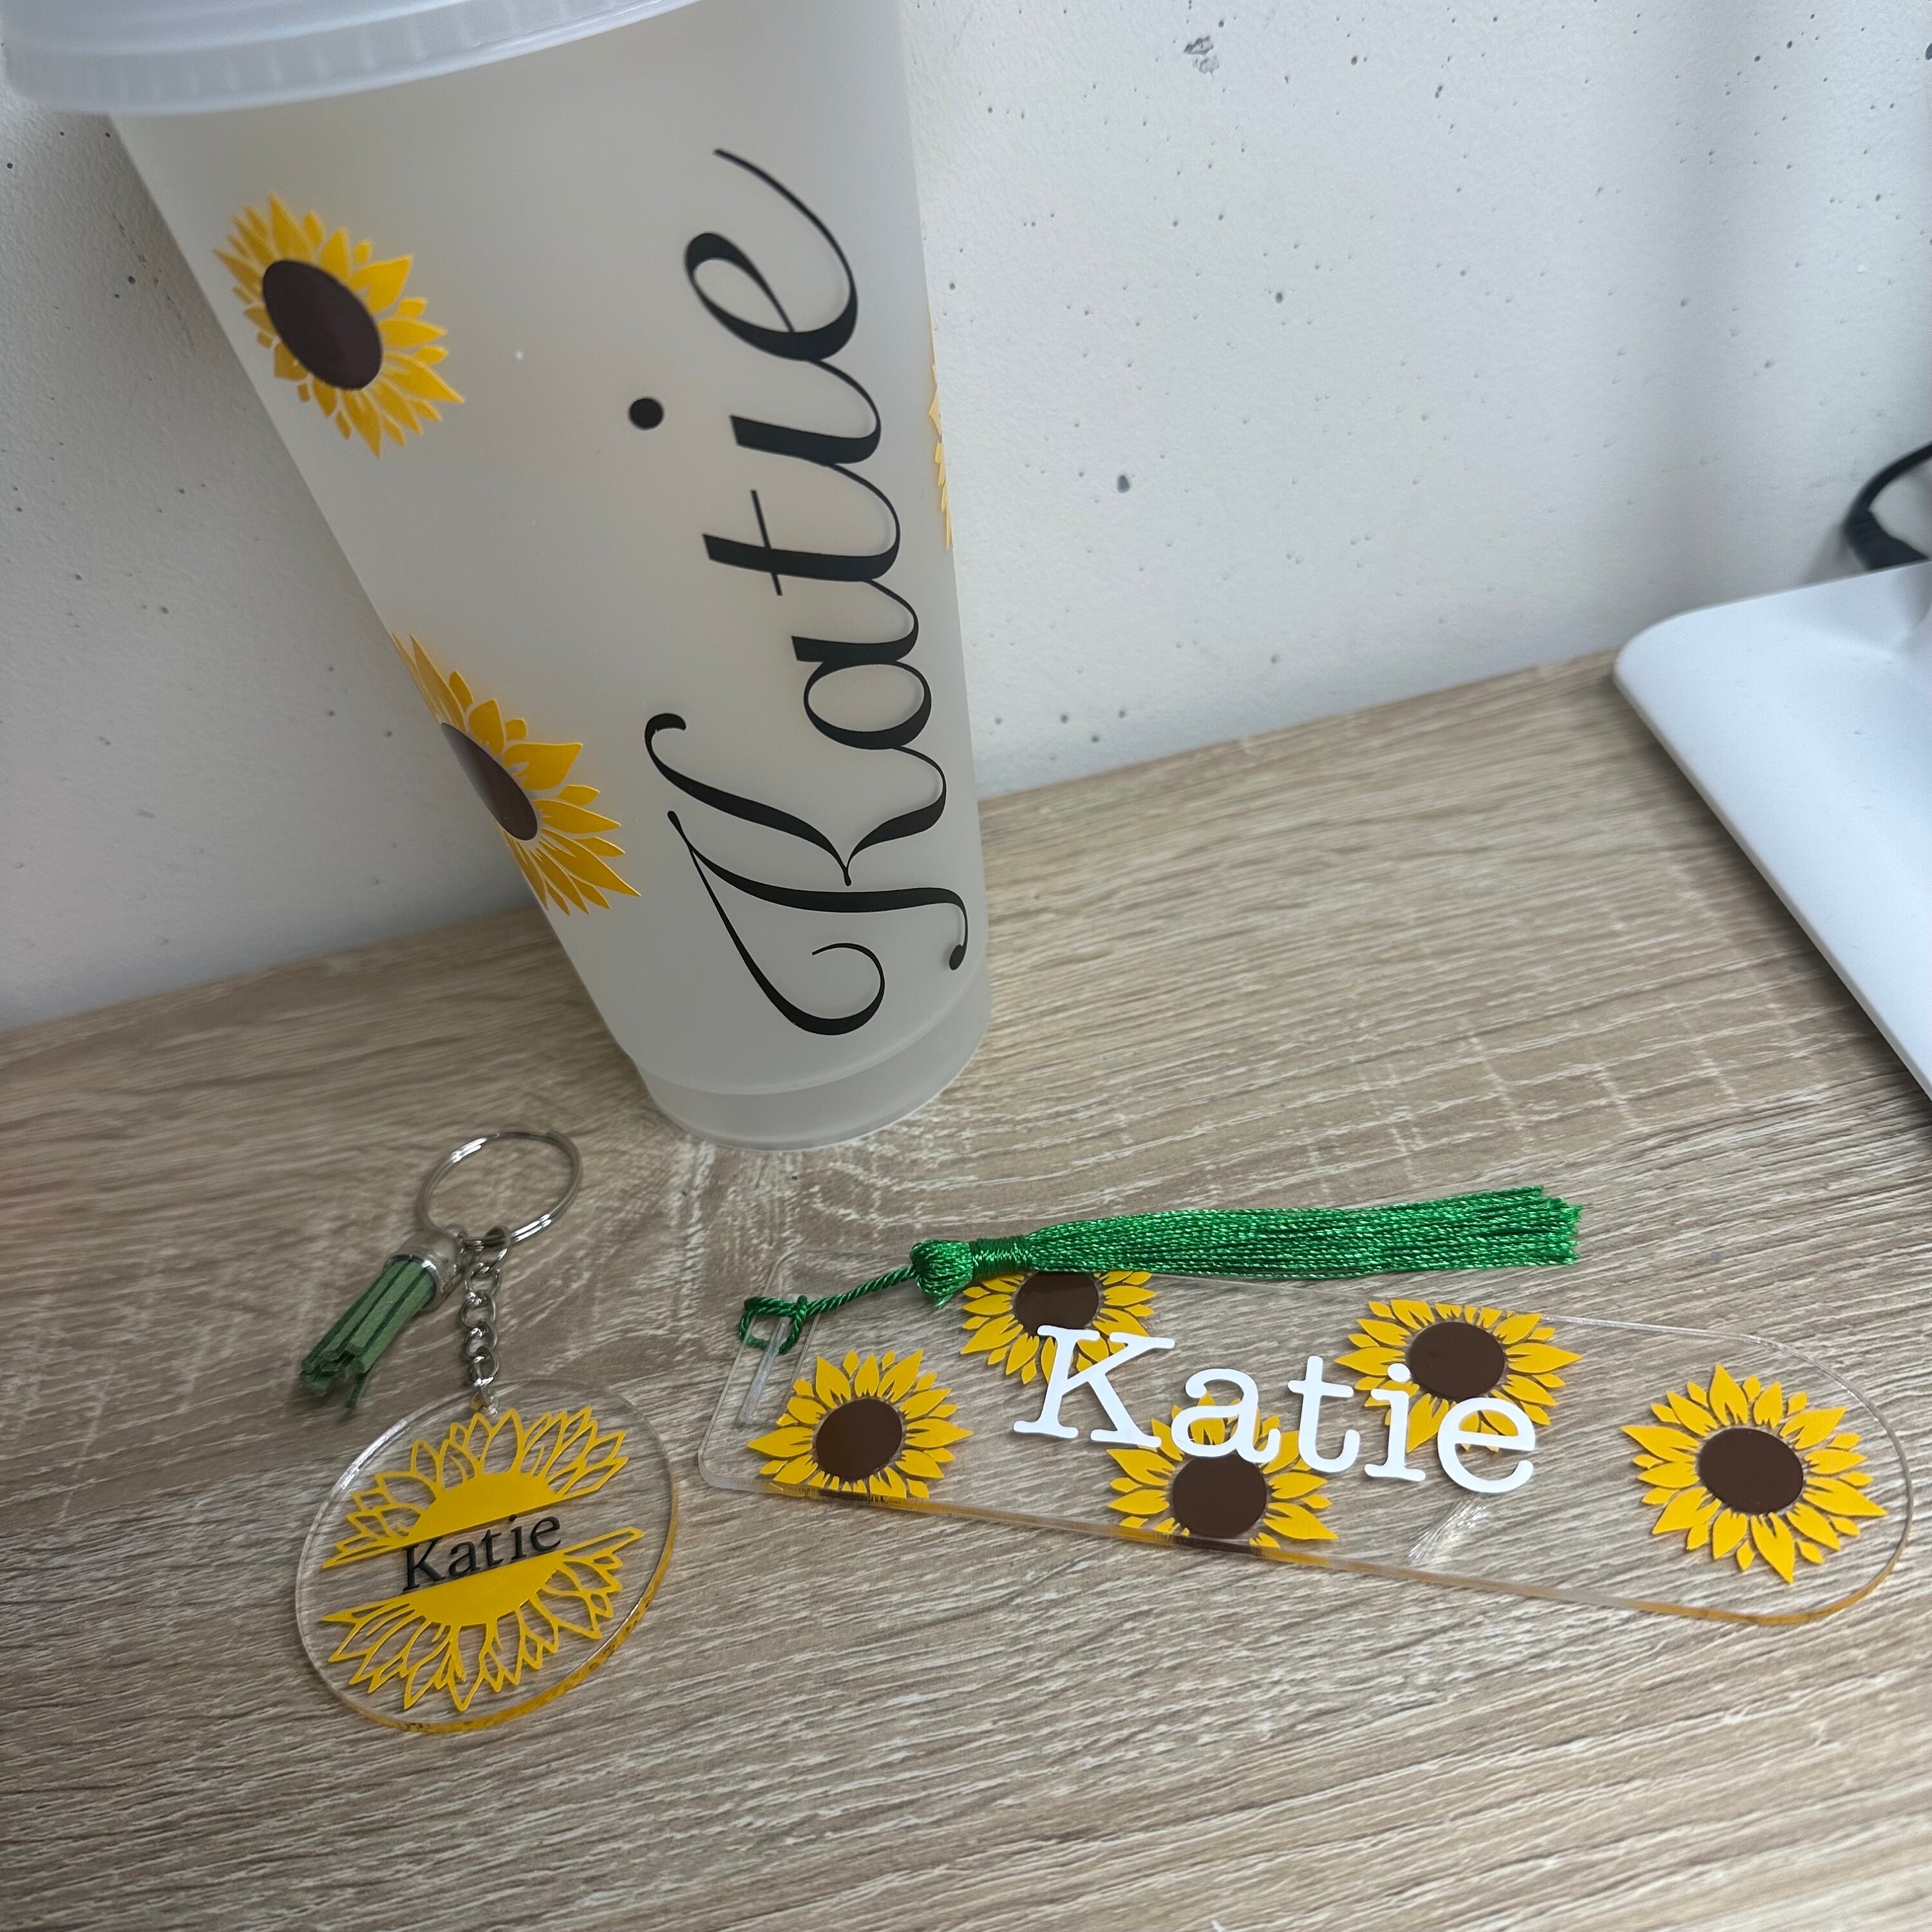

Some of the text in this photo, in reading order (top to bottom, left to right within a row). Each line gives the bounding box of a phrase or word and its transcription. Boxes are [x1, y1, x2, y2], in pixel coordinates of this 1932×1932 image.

[628, 148, 969, 1036] Katie
[1013, 1325, 1538, 1494] Katie
[402, 1514, 562, 1592] Katie
